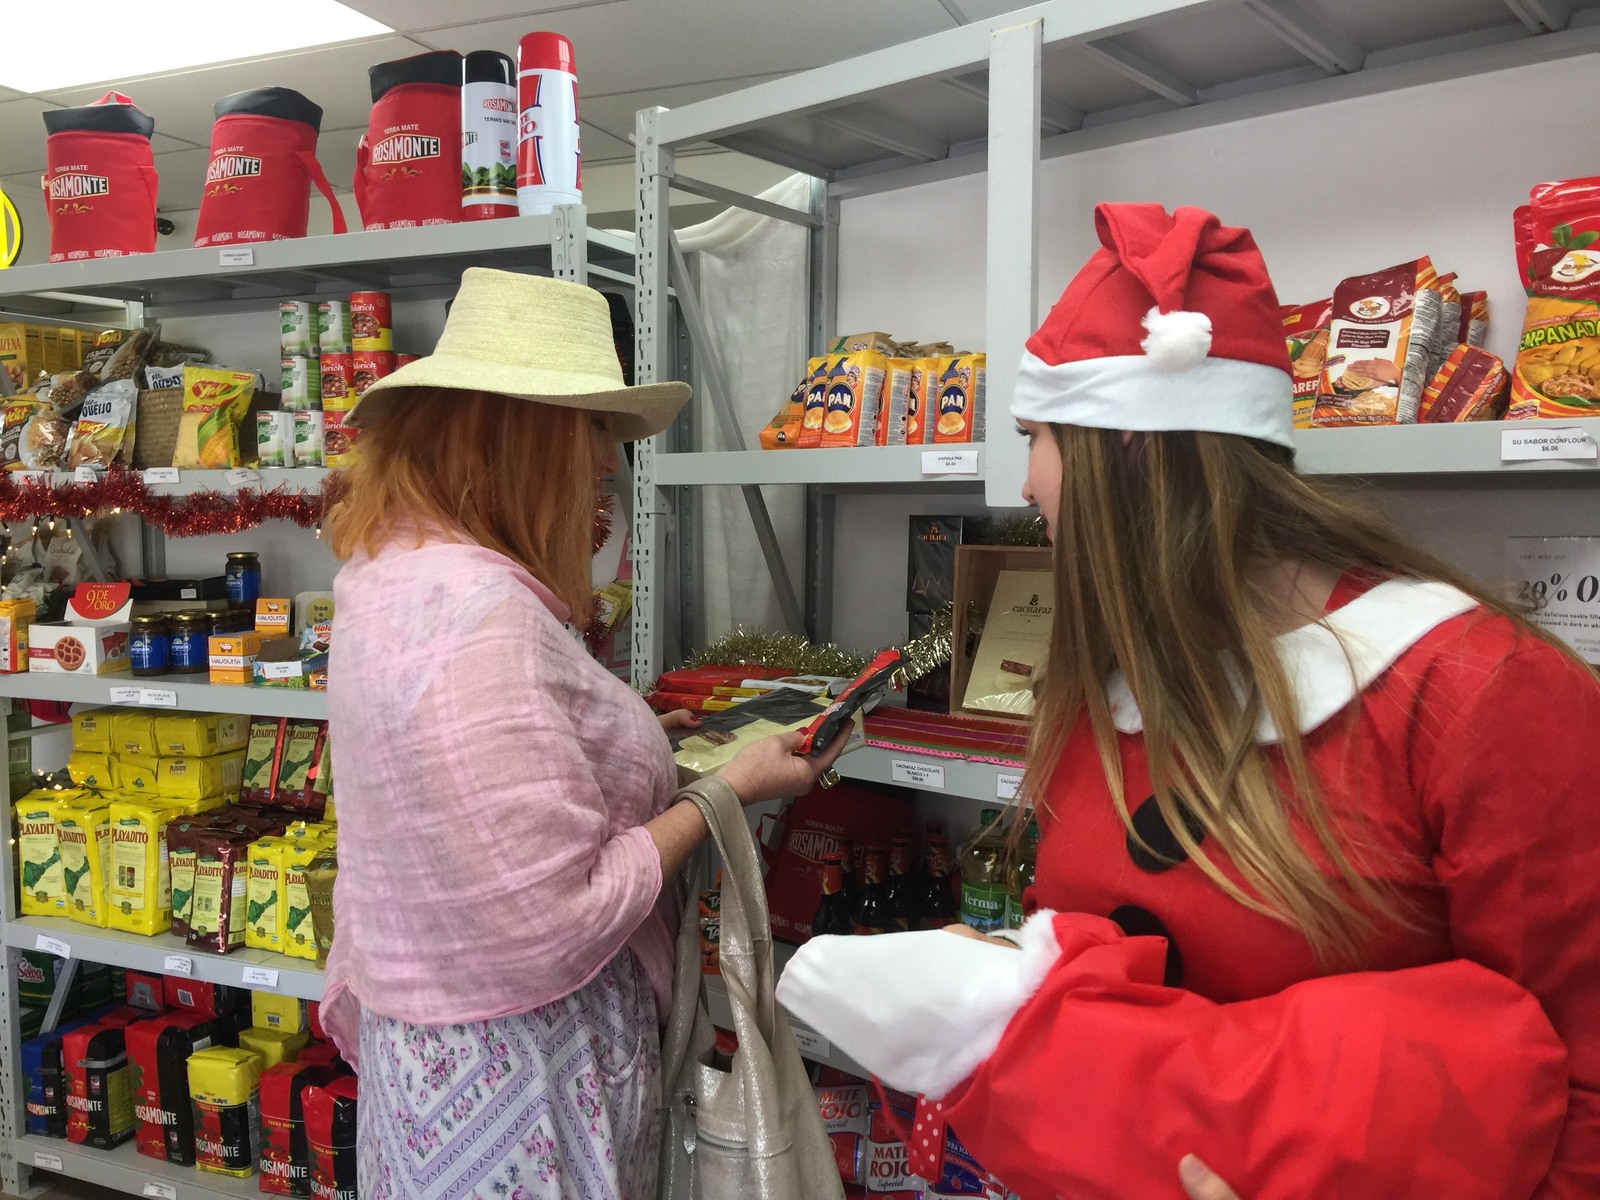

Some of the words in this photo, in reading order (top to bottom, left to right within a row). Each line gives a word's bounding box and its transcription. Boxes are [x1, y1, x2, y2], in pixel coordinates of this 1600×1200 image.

[384, 126, 400, 134] YERBA
[373, 136, 438, 163] ROSAMONTE
[82, 402, 112, 418] QUEIJO
[96, 590, 109, 600] DE
[1577, 575, 1600, 603] O
[86, 590, 96, 610] 9
[94, 600, 116, 611] ORO
[916, 766, 940, 774] CHOCOLATE
[57, 829, 87, 844] PLAYADITO
[112, 828, 148, 844] PLAYADITO
[964, 892, 998, 910] Terma
[195, 1138, 240, 1157] ROSAMONTE
[878, 1178, 905, 1189] Especial
